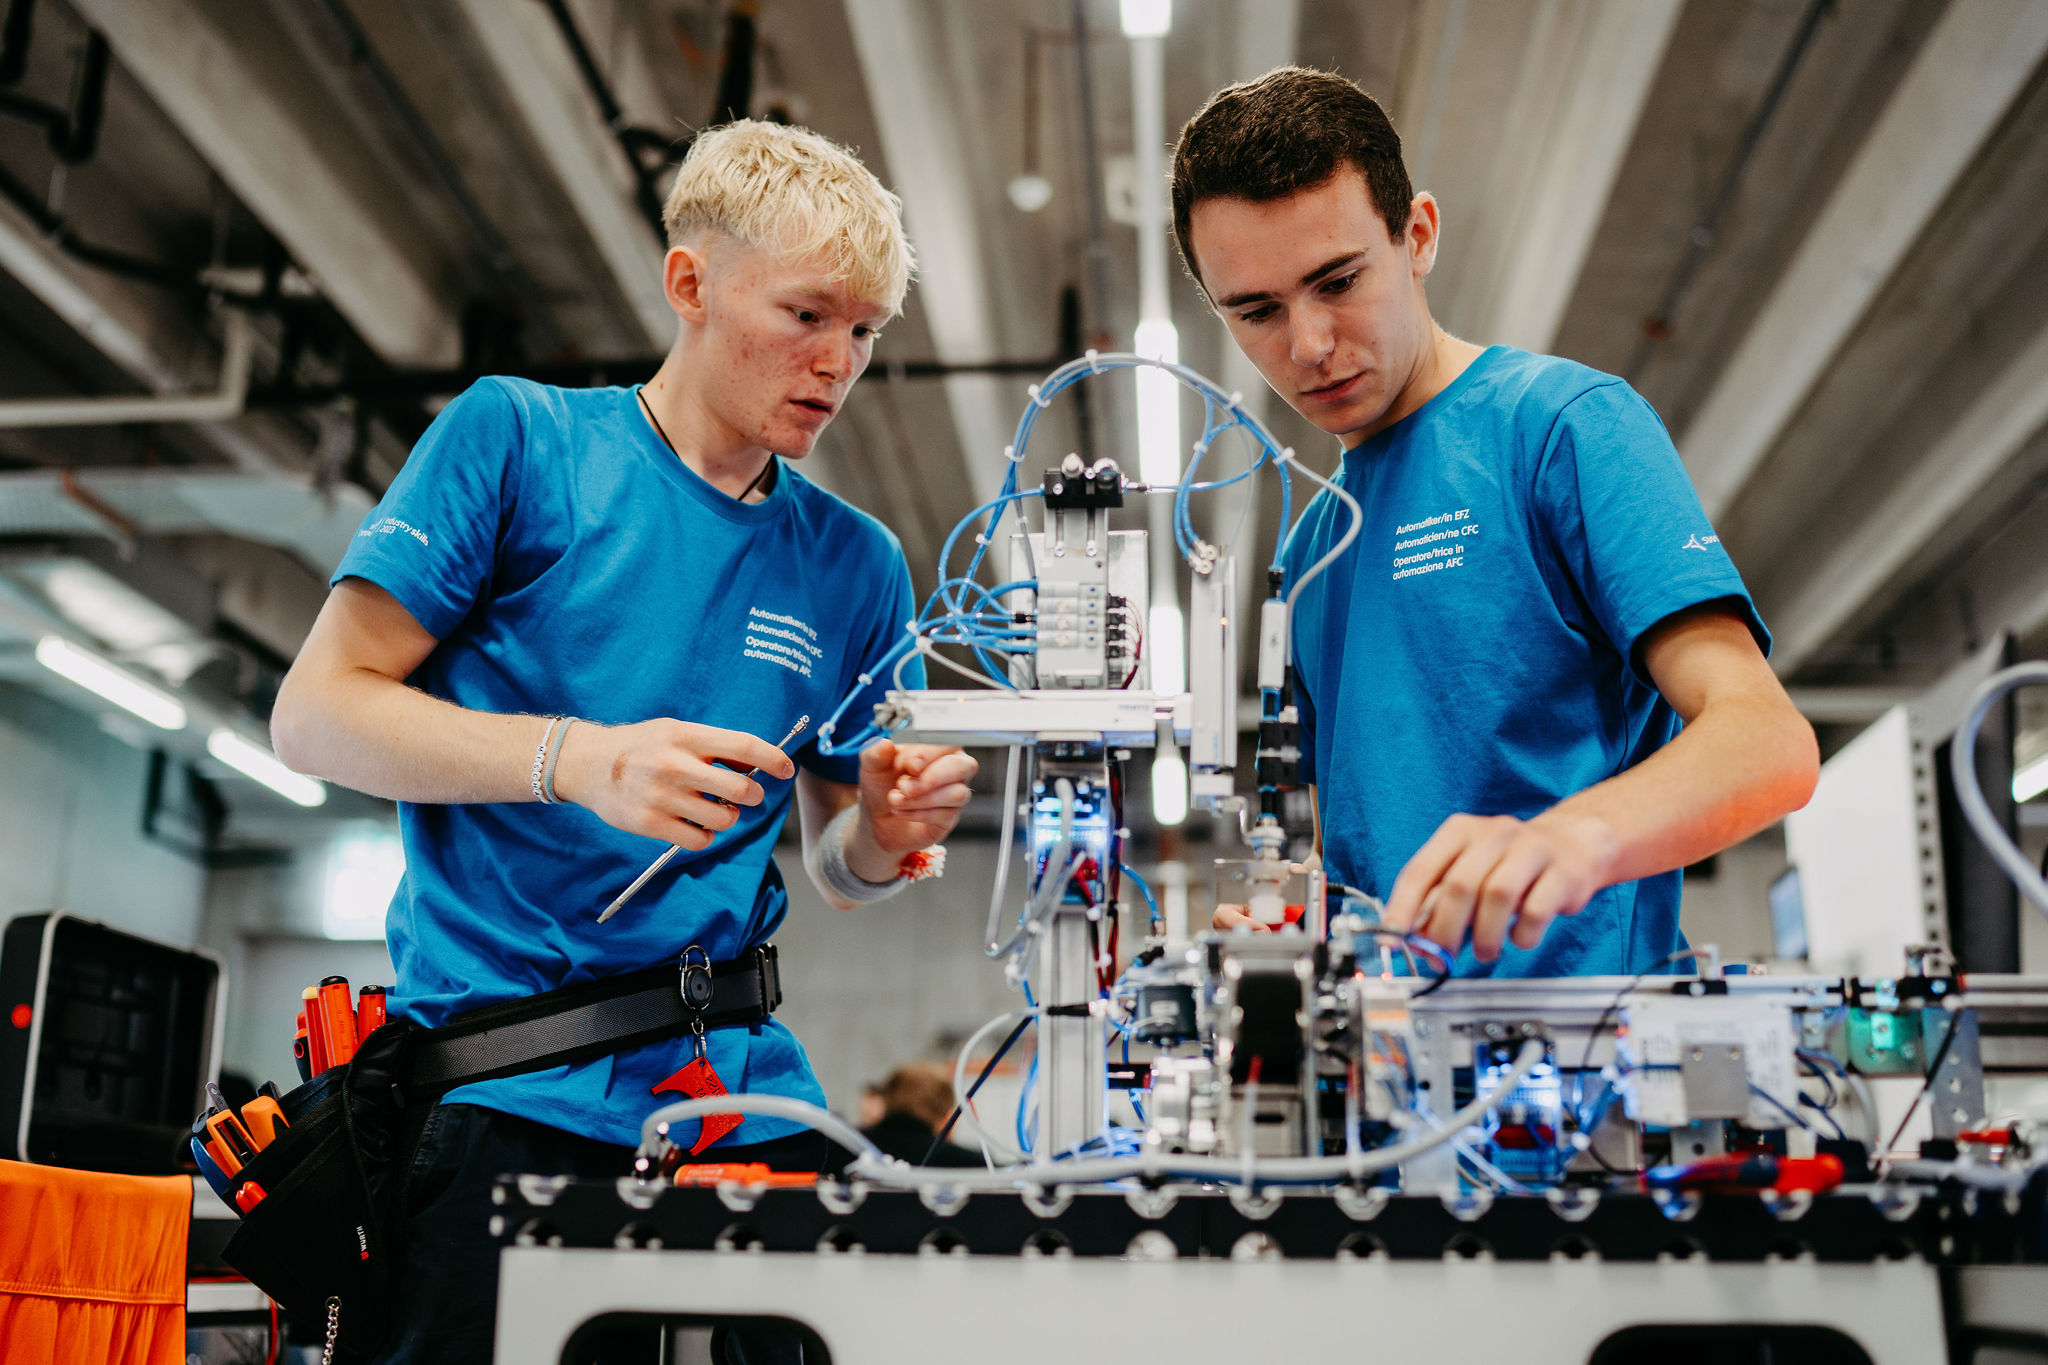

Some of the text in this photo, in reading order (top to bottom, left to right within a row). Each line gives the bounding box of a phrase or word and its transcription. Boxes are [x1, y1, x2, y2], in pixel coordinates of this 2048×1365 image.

[1396, 508, 1470, 535] Automatiker/in EFZ
[1394, 524, 1479, 551] Automaticien/ne CFC
[1392, 556, 1464, 580] automazione AFC
[1393, 544, 1464, 568] Operatore/trice in
[744, 649, 799, 671] automazione
